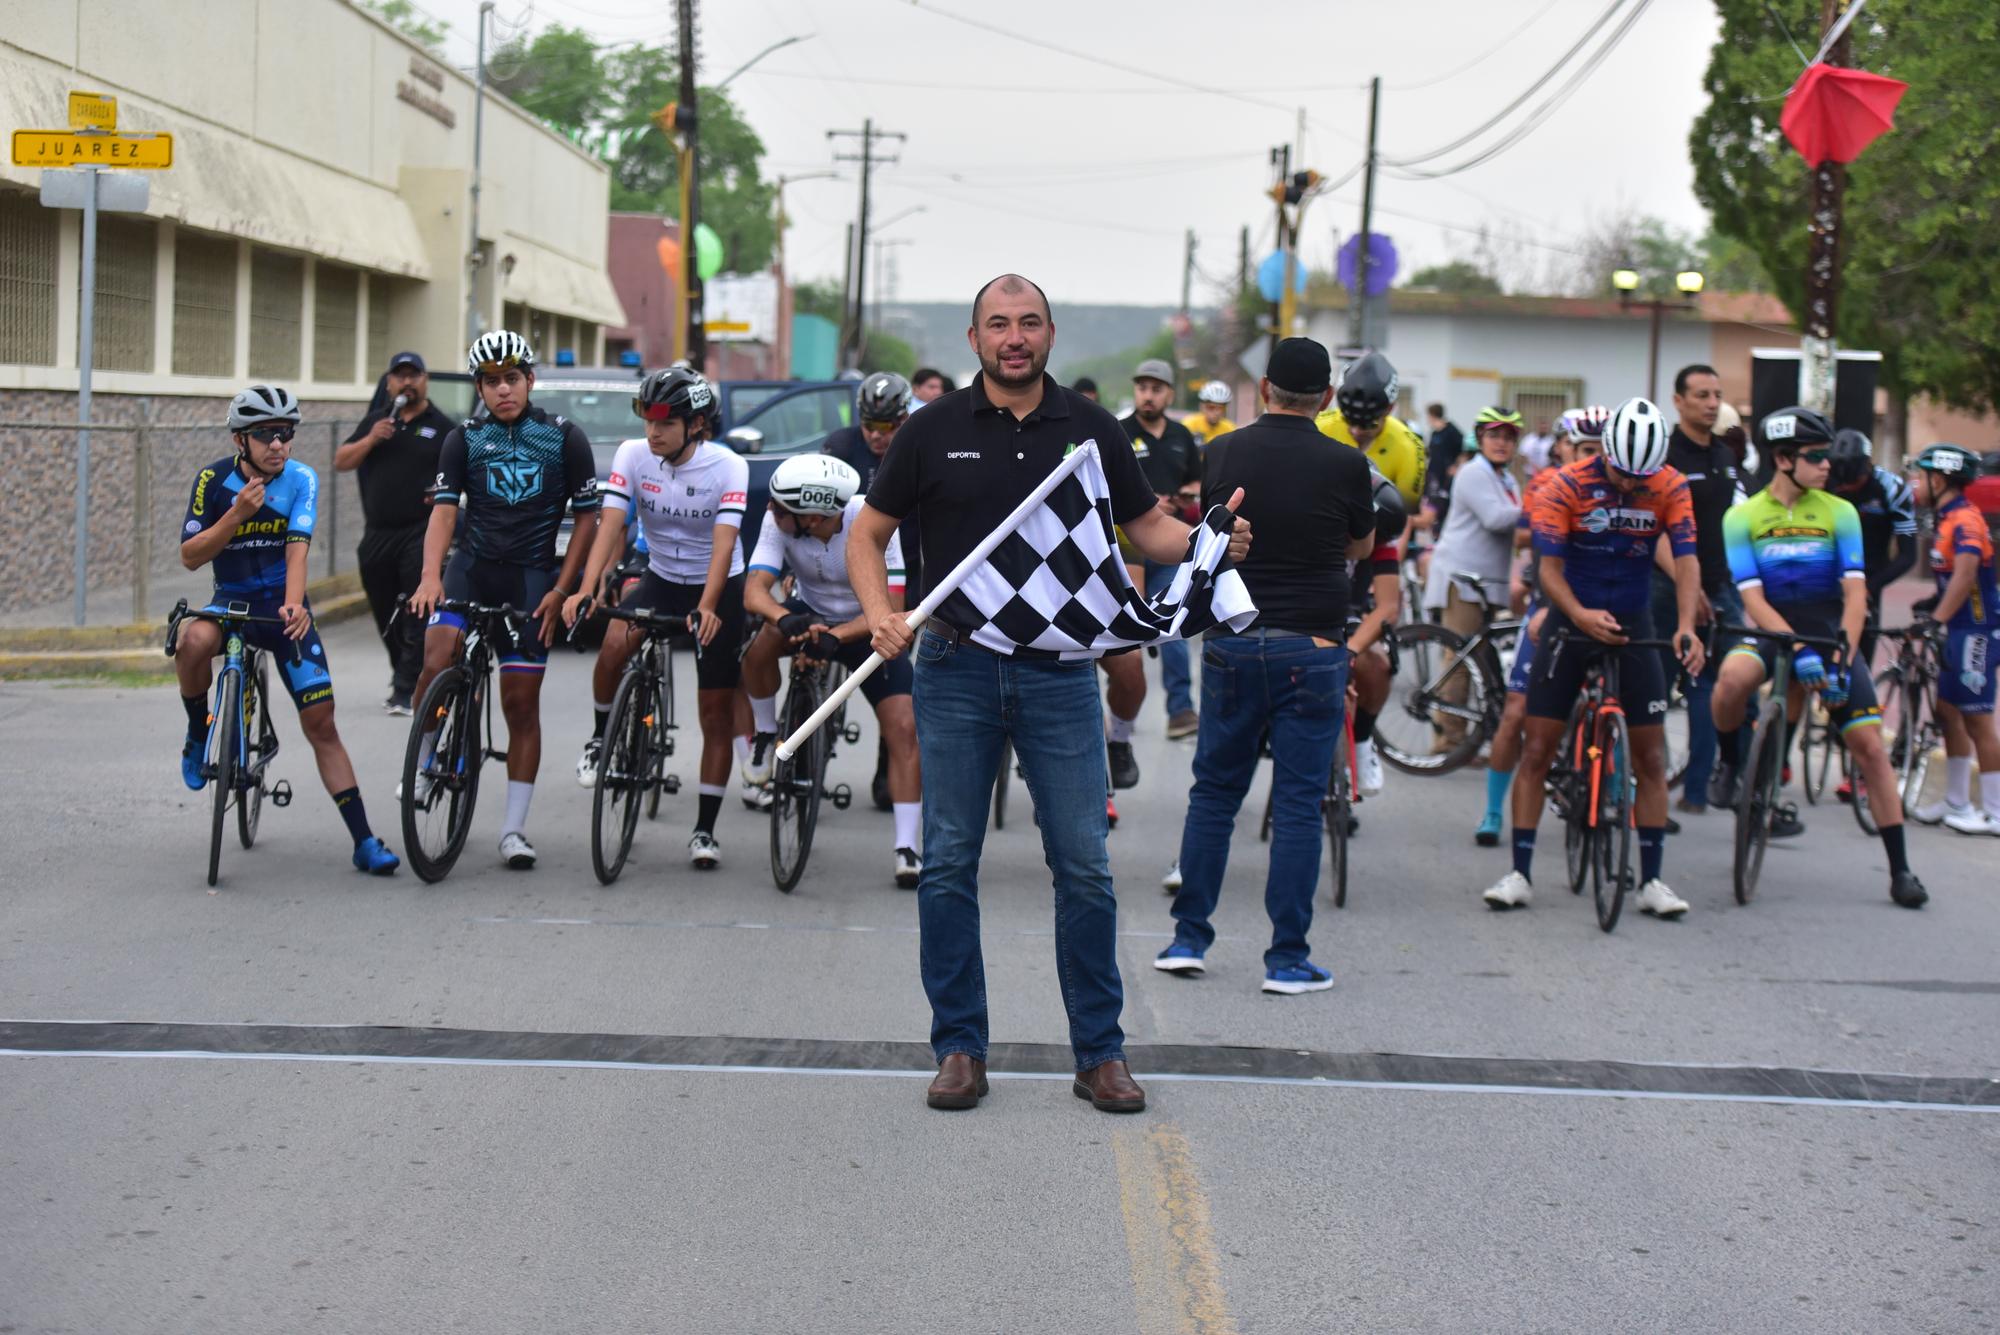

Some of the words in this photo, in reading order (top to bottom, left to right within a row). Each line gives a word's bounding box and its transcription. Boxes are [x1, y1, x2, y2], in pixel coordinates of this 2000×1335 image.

[38, 142, 139, 158] JUAREZ
[947, 451, 981, 459] DEPORTES
[803, 490, 833, 505] 006
[662, 506, 712, 519] NAIRO
